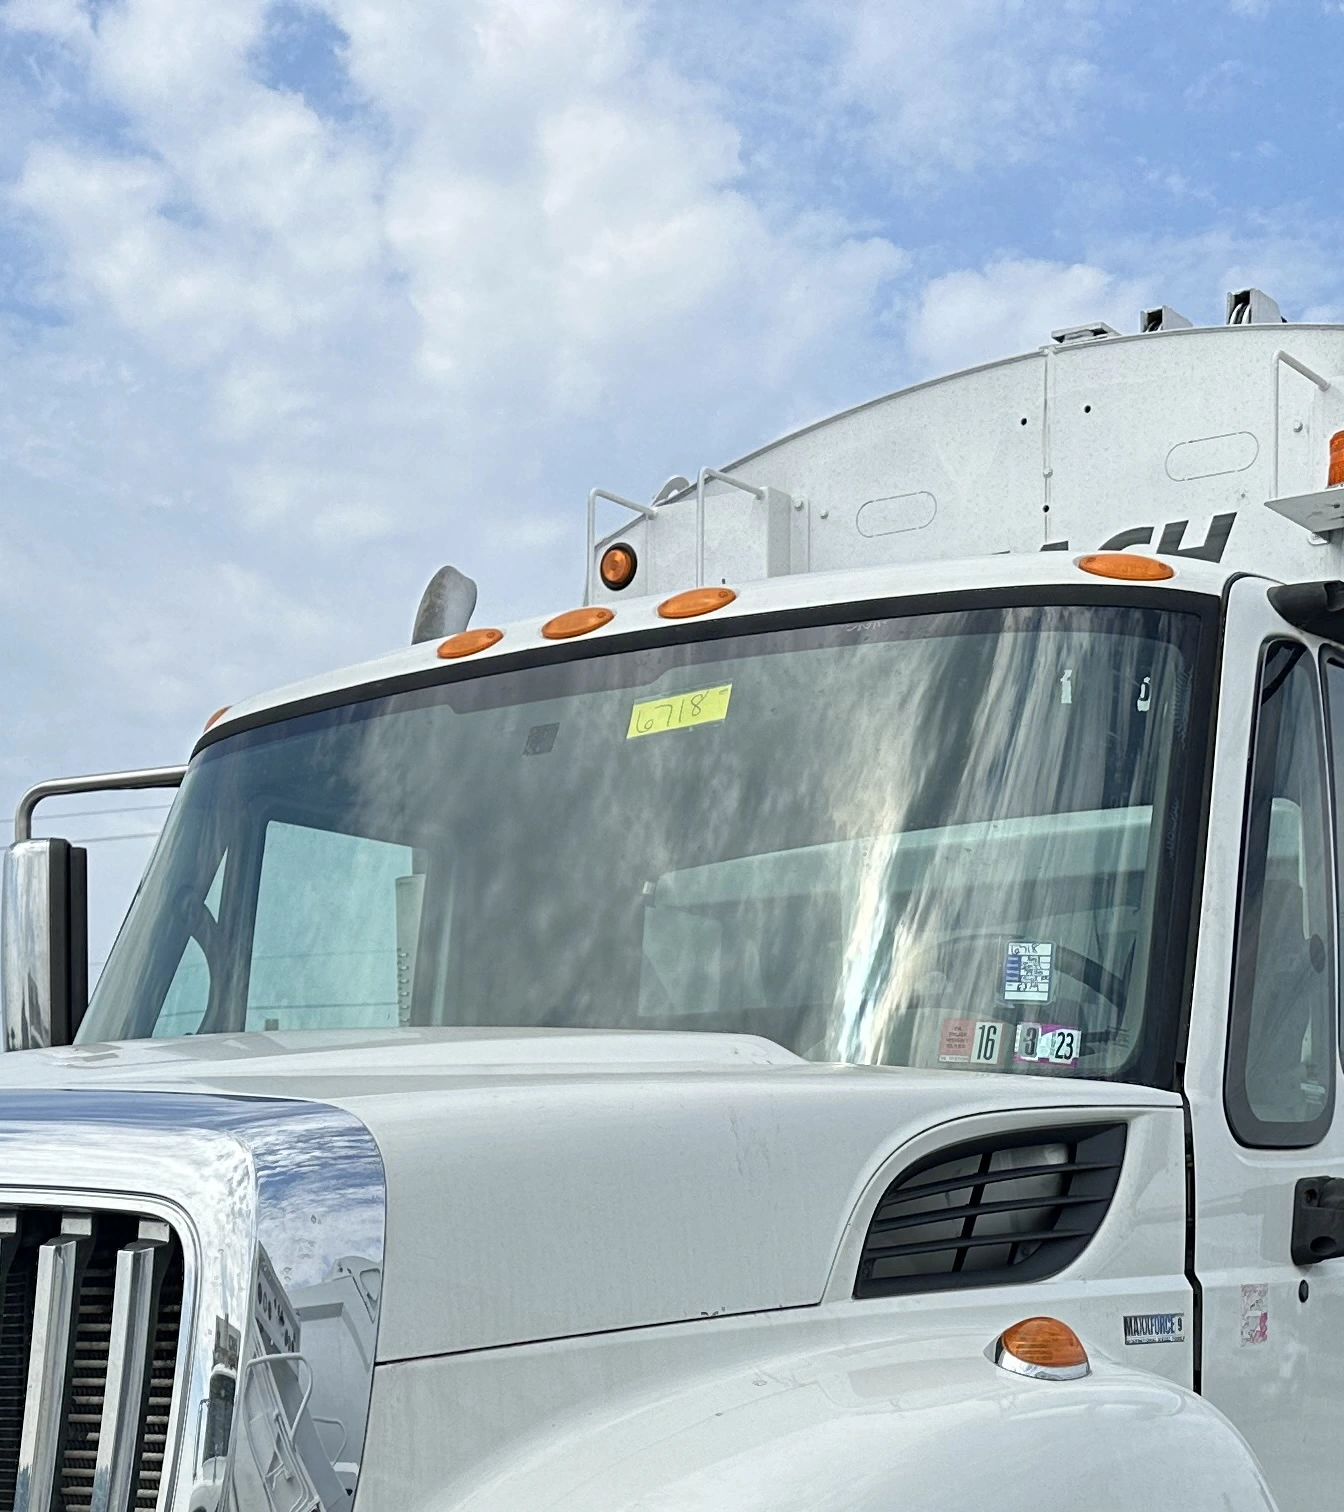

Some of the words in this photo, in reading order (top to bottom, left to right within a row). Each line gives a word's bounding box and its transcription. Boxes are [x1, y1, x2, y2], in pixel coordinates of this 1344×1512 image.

[636, 690, 709, 733] 6718
[976, 1024, 997, 1060] 16
[1055, 1031, 1074, 1060] 23
[1124, 1316, 1175, 1336] MAXXFORCE
